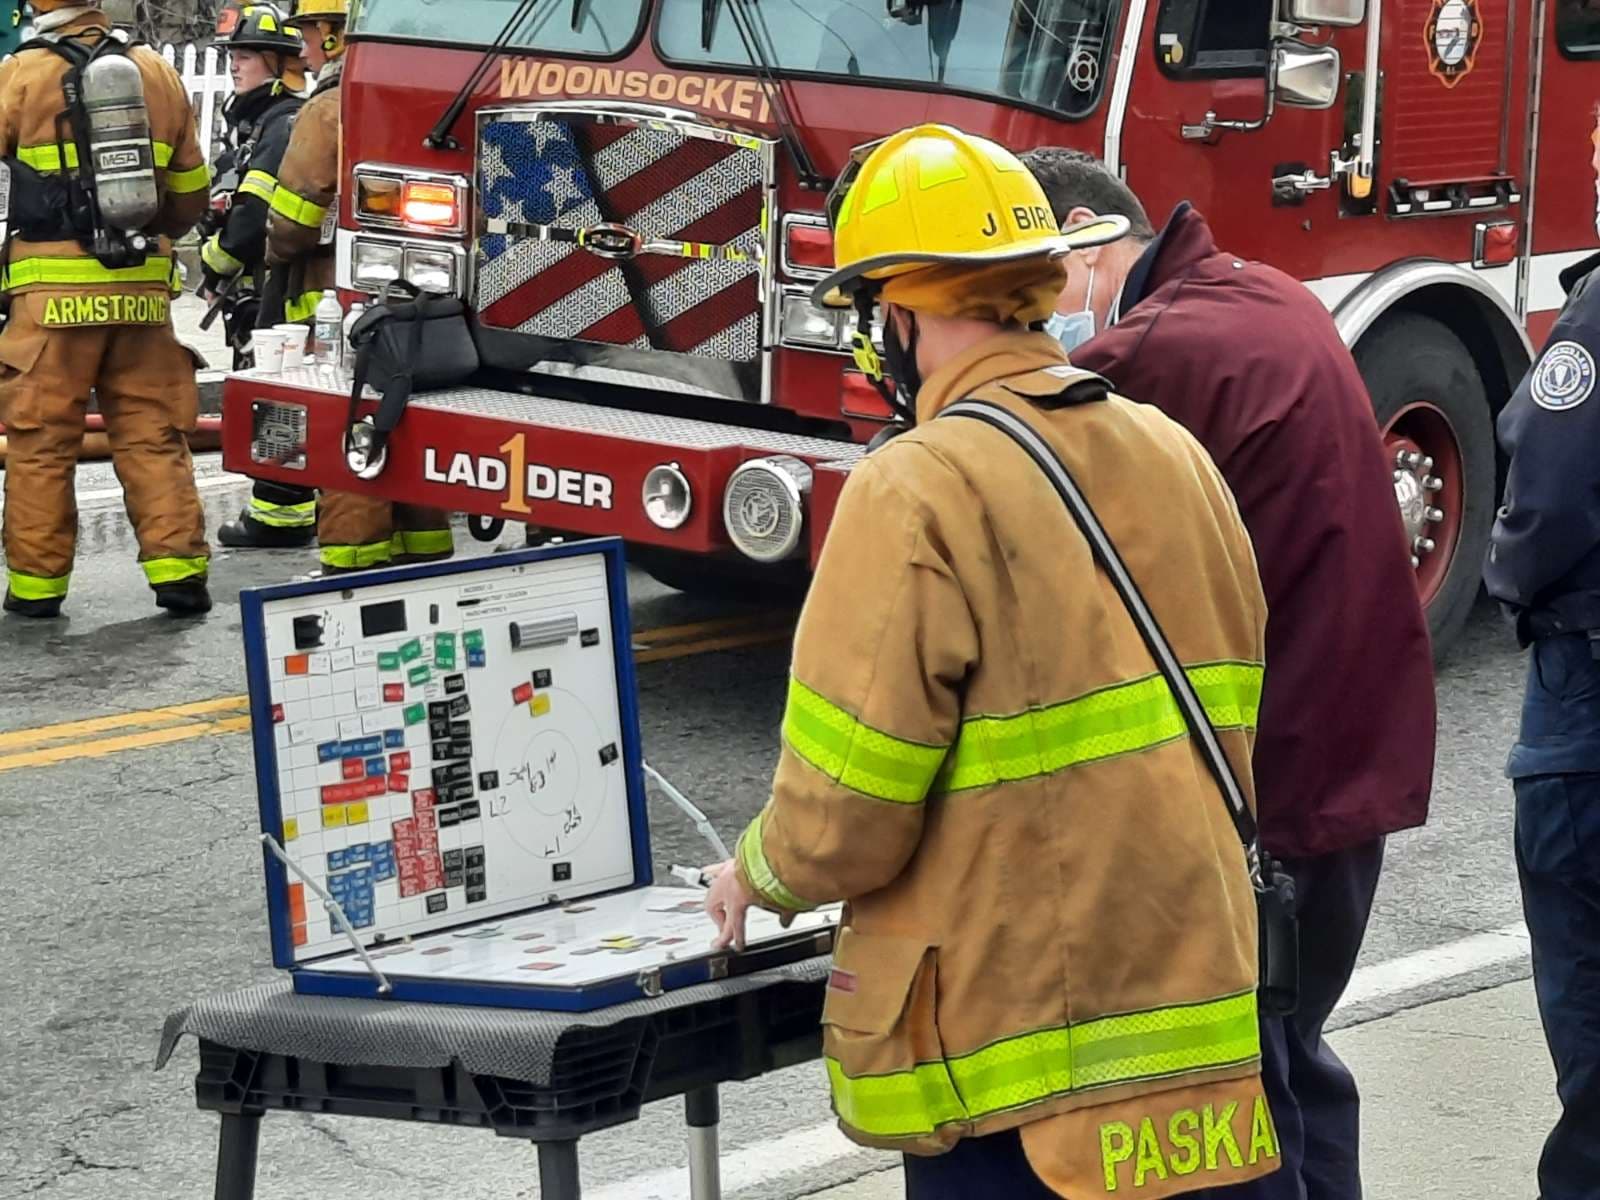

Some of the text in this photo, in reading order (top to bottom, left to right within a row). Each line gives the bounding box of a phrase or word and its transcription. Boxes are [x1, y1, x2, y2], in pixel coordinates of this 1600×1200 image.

[499, 58, 781, 123] WOONSOCKET
[101, 150, 139, 168] MSA
[981, 211, 998, 237] J
[43, 294, 168, 325] ARMSTRONG
[1099, 1095, 1280, 1191] PASKA
